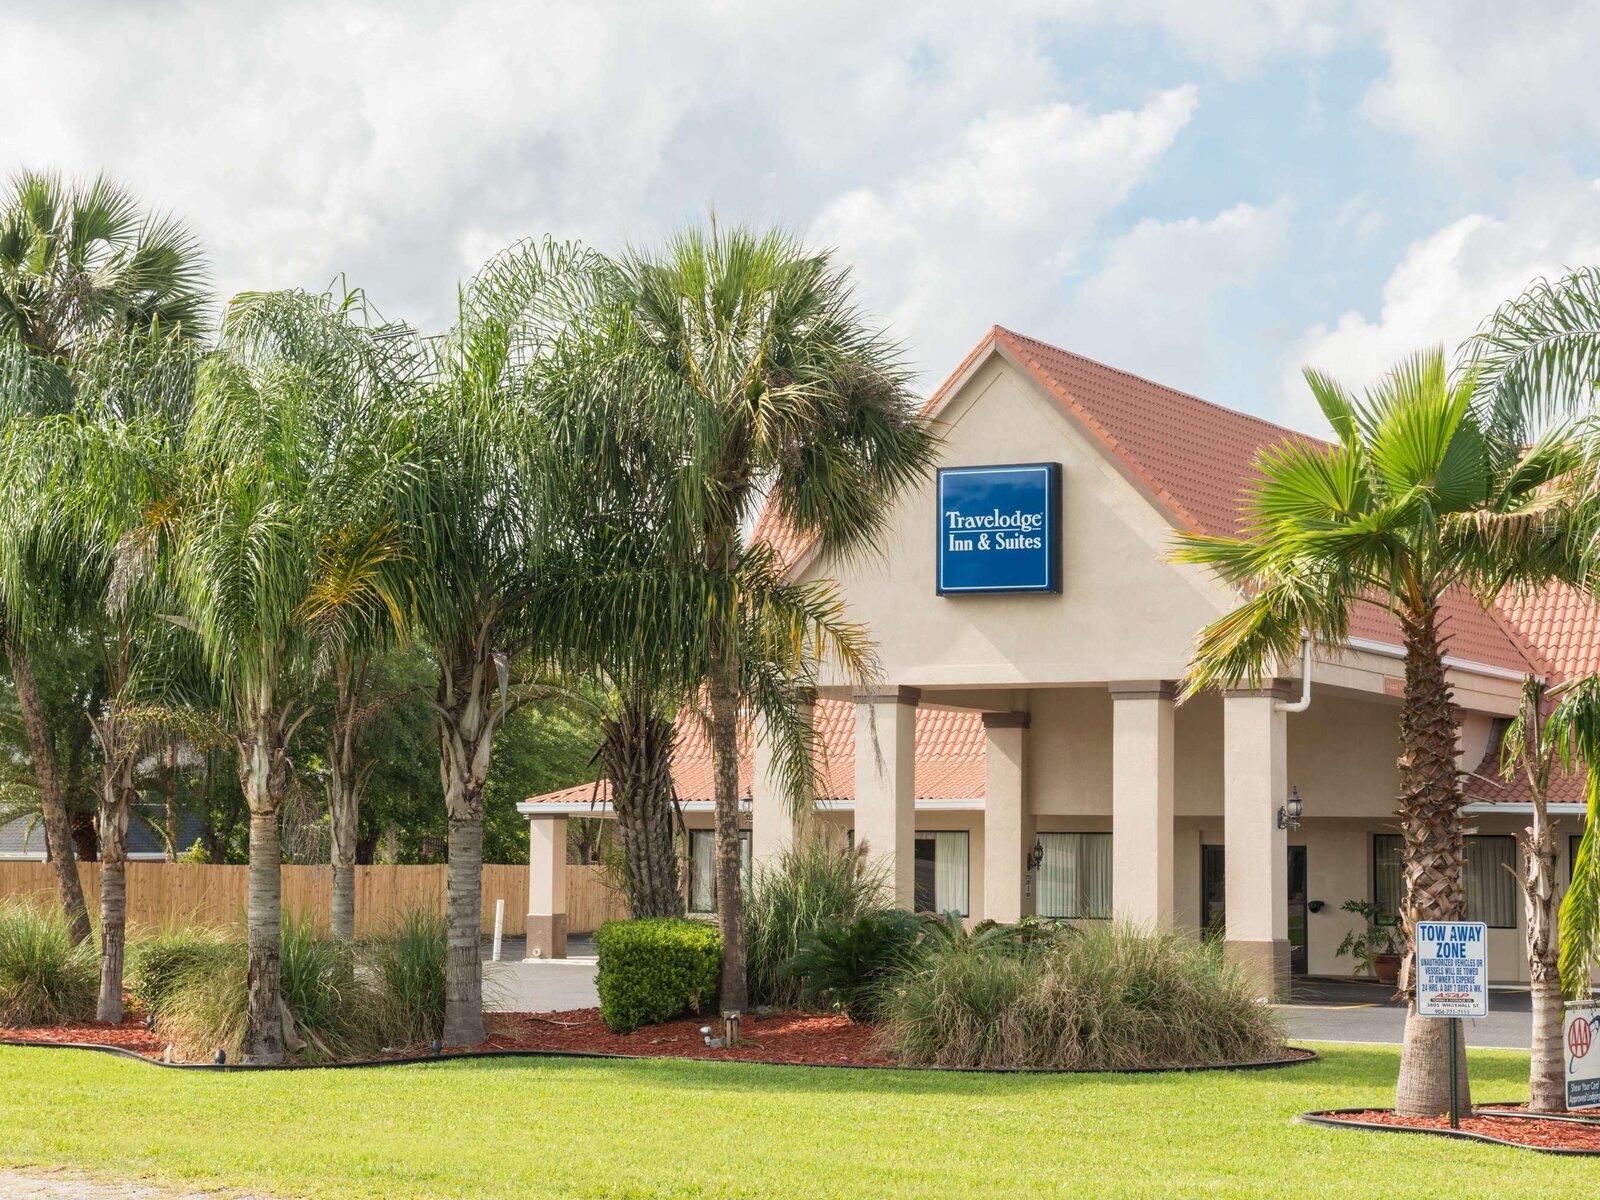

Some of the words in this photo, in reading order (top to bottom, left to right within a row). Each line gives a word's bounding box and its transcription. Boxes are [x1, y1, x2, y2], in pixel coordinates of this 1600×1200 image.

[945, 508, 1042, 532] Travelodge
[948, 534, 973, 551] Inn
[977, 533, 991, 550] &
[995, 532, 1042, 550] Suites
[1420, 926, 1446, 941] TOW
[1450, 926, 1482, 942] AWAY
[1436, 943, 1466, 958] ZONE
[1455, 959, 1476, 967] VEHICLES
[1476, 959, 1483, 967] OR
[1425, 967, 1444, 975] VESSELS
[1456, 976, 1475, 984] EXPENSE
[1422, 984, 1428, 992] 24
[1569, 1018, 1591, 1058] AAA
[1570, 1083, 1581, 1092] Show
[1582, 1082, 1590, 1091] Your
[1591, 1081, 1600, 1090] Card
[1570, 1094, 1586, 1105] Approved
